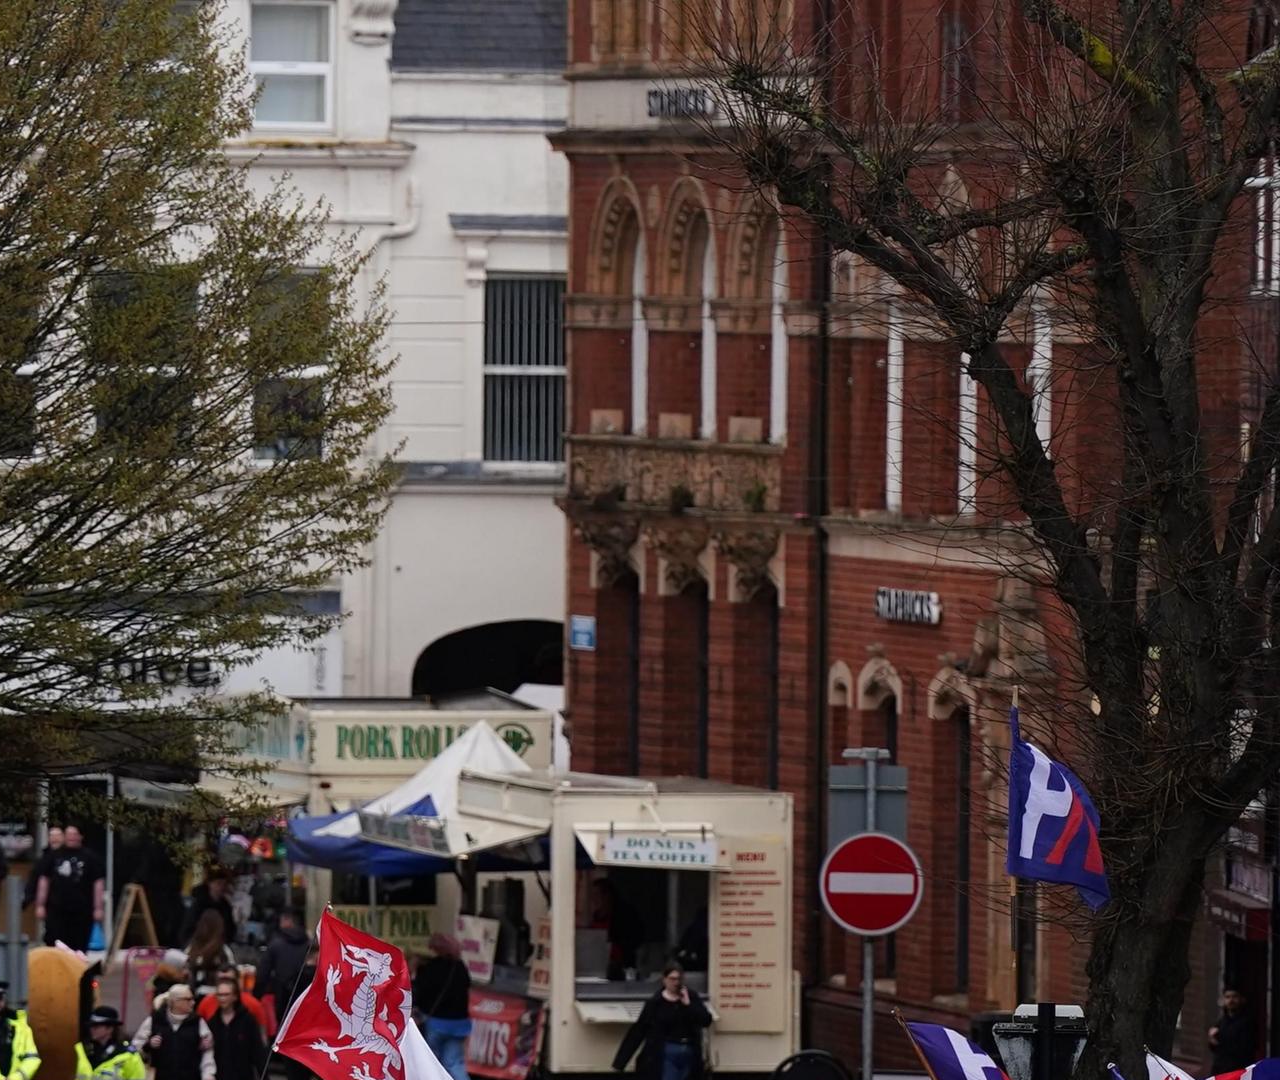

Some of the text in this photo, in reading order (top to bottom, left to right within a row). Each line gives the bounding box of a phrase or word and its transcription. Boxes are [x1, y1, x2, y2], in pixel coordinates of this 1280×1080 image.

[336, 725, 396, 759] PORK
[613, 851, 710, 863] TEA COFFEE
